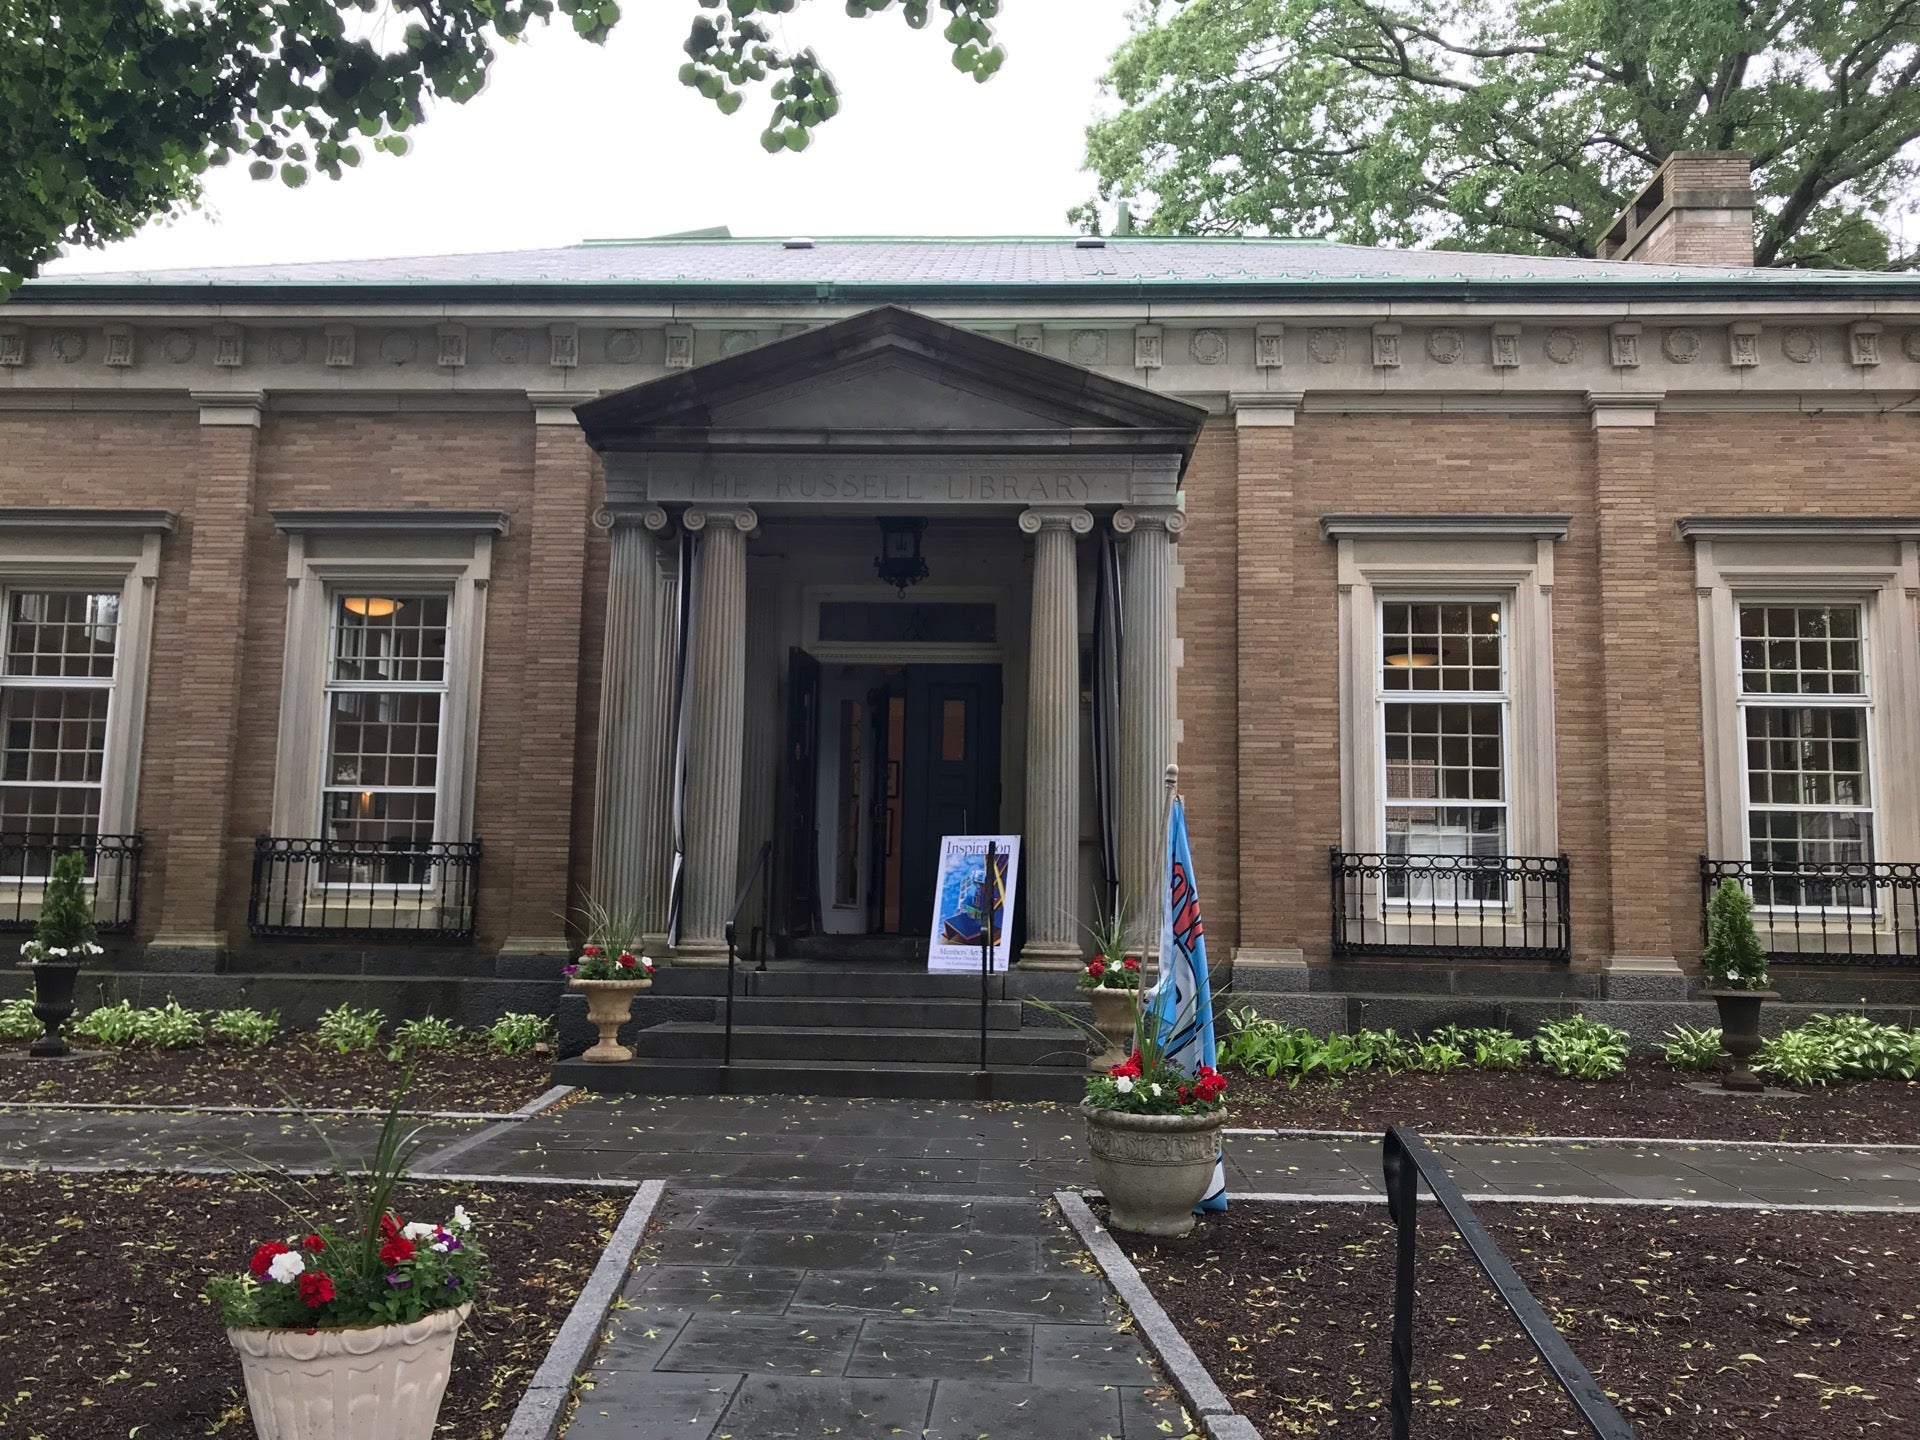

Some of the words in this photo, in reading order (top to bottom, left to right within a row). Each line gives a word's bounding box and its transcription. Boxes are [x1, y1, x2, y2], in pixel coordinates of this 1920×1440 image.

[685, 474, 749, 498] THE
[777, 474, 921, 499] RUSSELL
[948, 474, 1098, 499] LIBRARY
[946, 841, 1011, 855] Inspiraon
